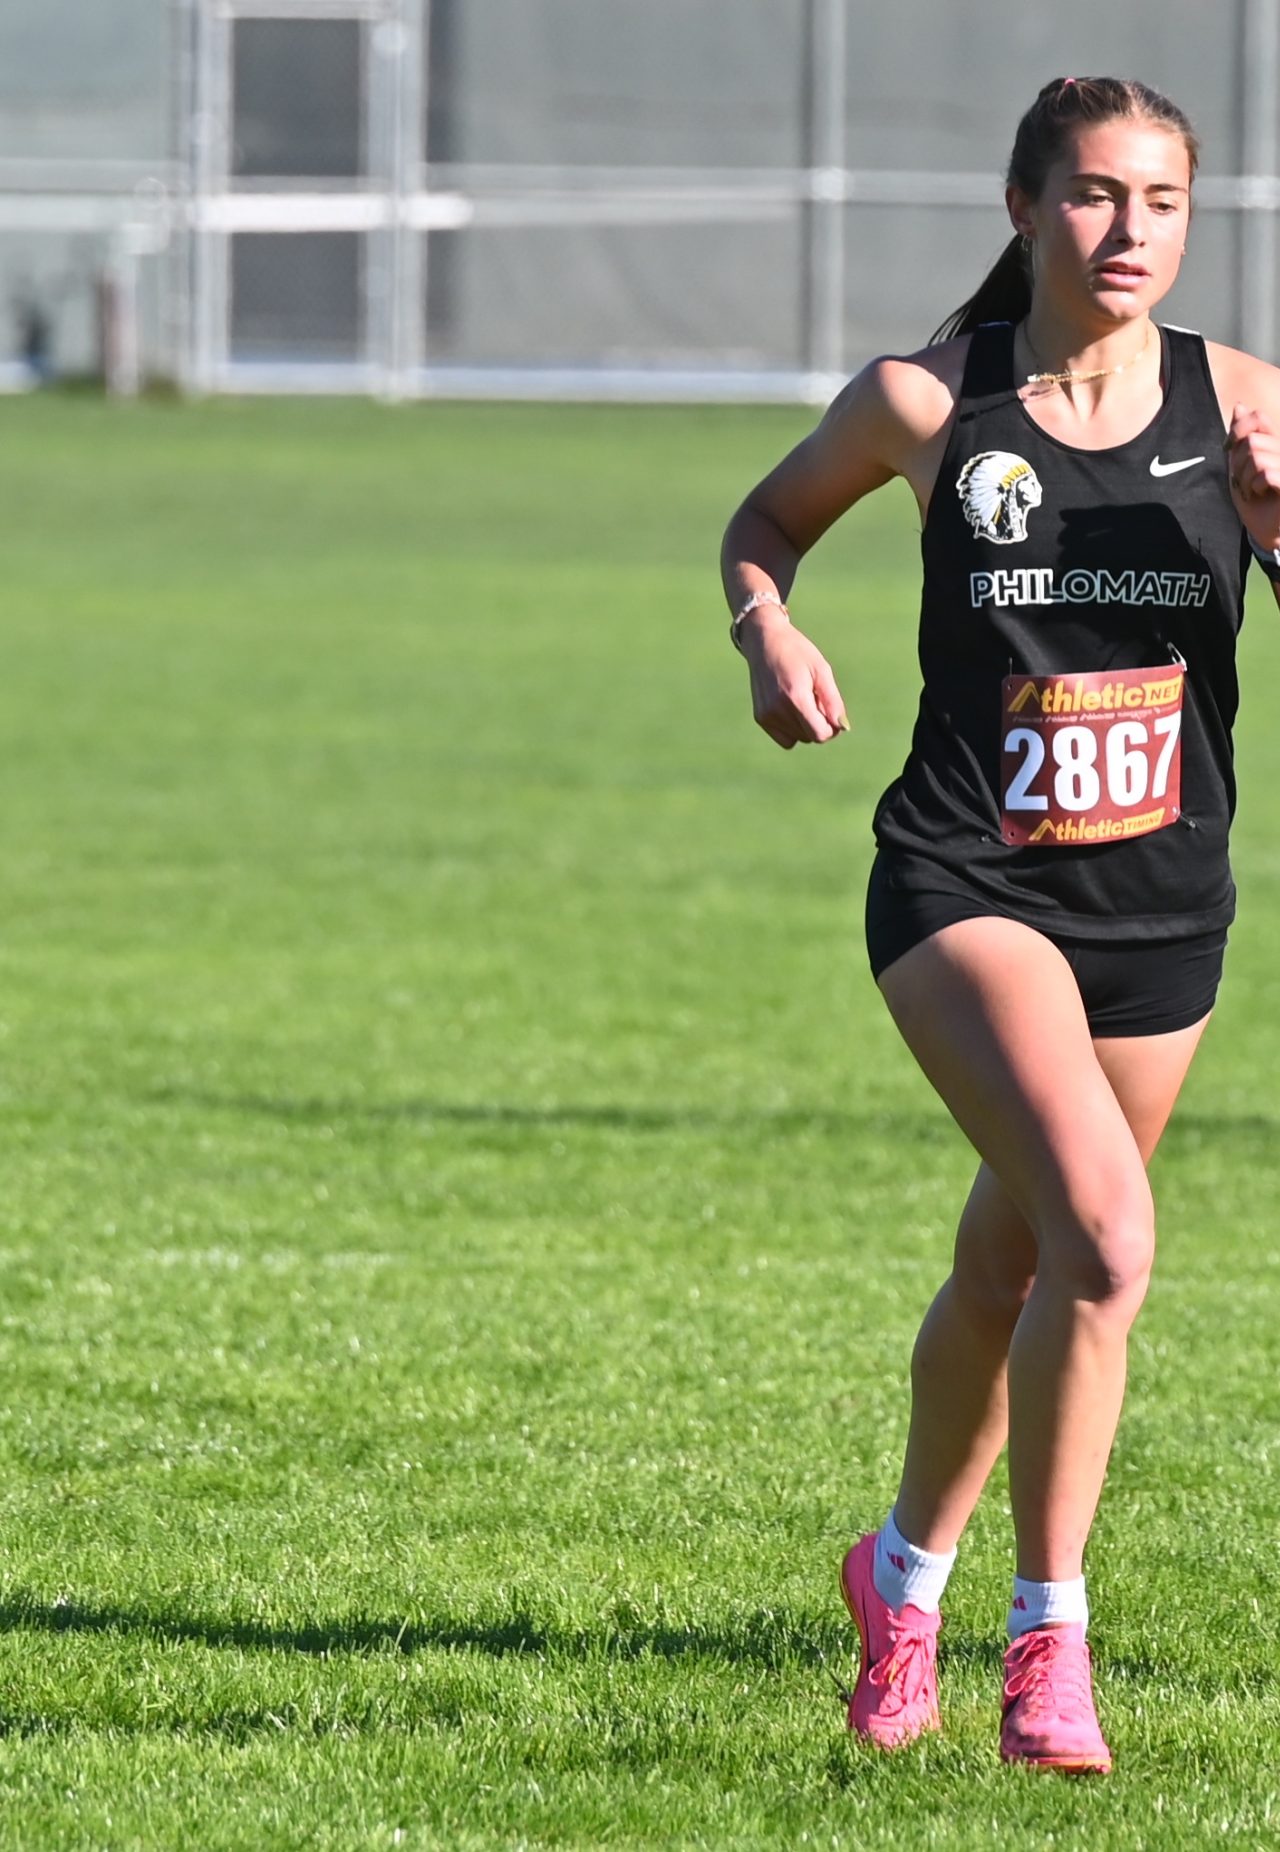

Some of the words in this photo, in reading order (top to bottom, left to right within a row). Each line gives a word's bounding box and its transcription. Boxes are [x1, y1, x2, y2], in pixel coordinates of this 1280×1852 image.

[970, 568, 1210, 608] PHILOMATH
[1007, 680, 1145, 713] Athletic
[1149, 682, 1181, 702] NET
[1004, 710, 1182, 812] 2867
[1028, 818, 1123, 842] Athletic
